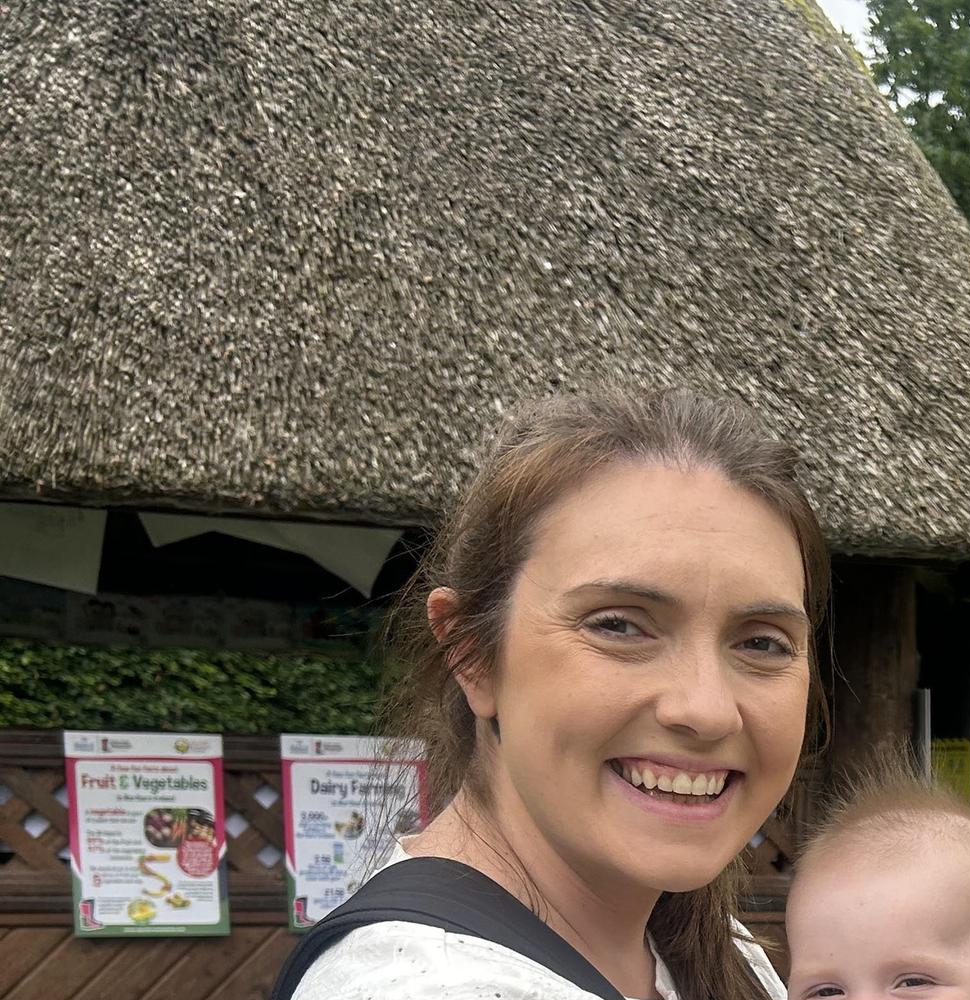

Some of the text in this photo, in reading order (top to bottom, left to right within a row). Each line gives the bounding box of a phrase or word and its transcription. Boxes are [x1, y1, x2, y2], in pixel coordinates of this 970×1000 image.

[81, 773, 116, 790] Fruit
[132, 774, 208, 795] Vegetables
[311, 777, 348, 799] Dairy
